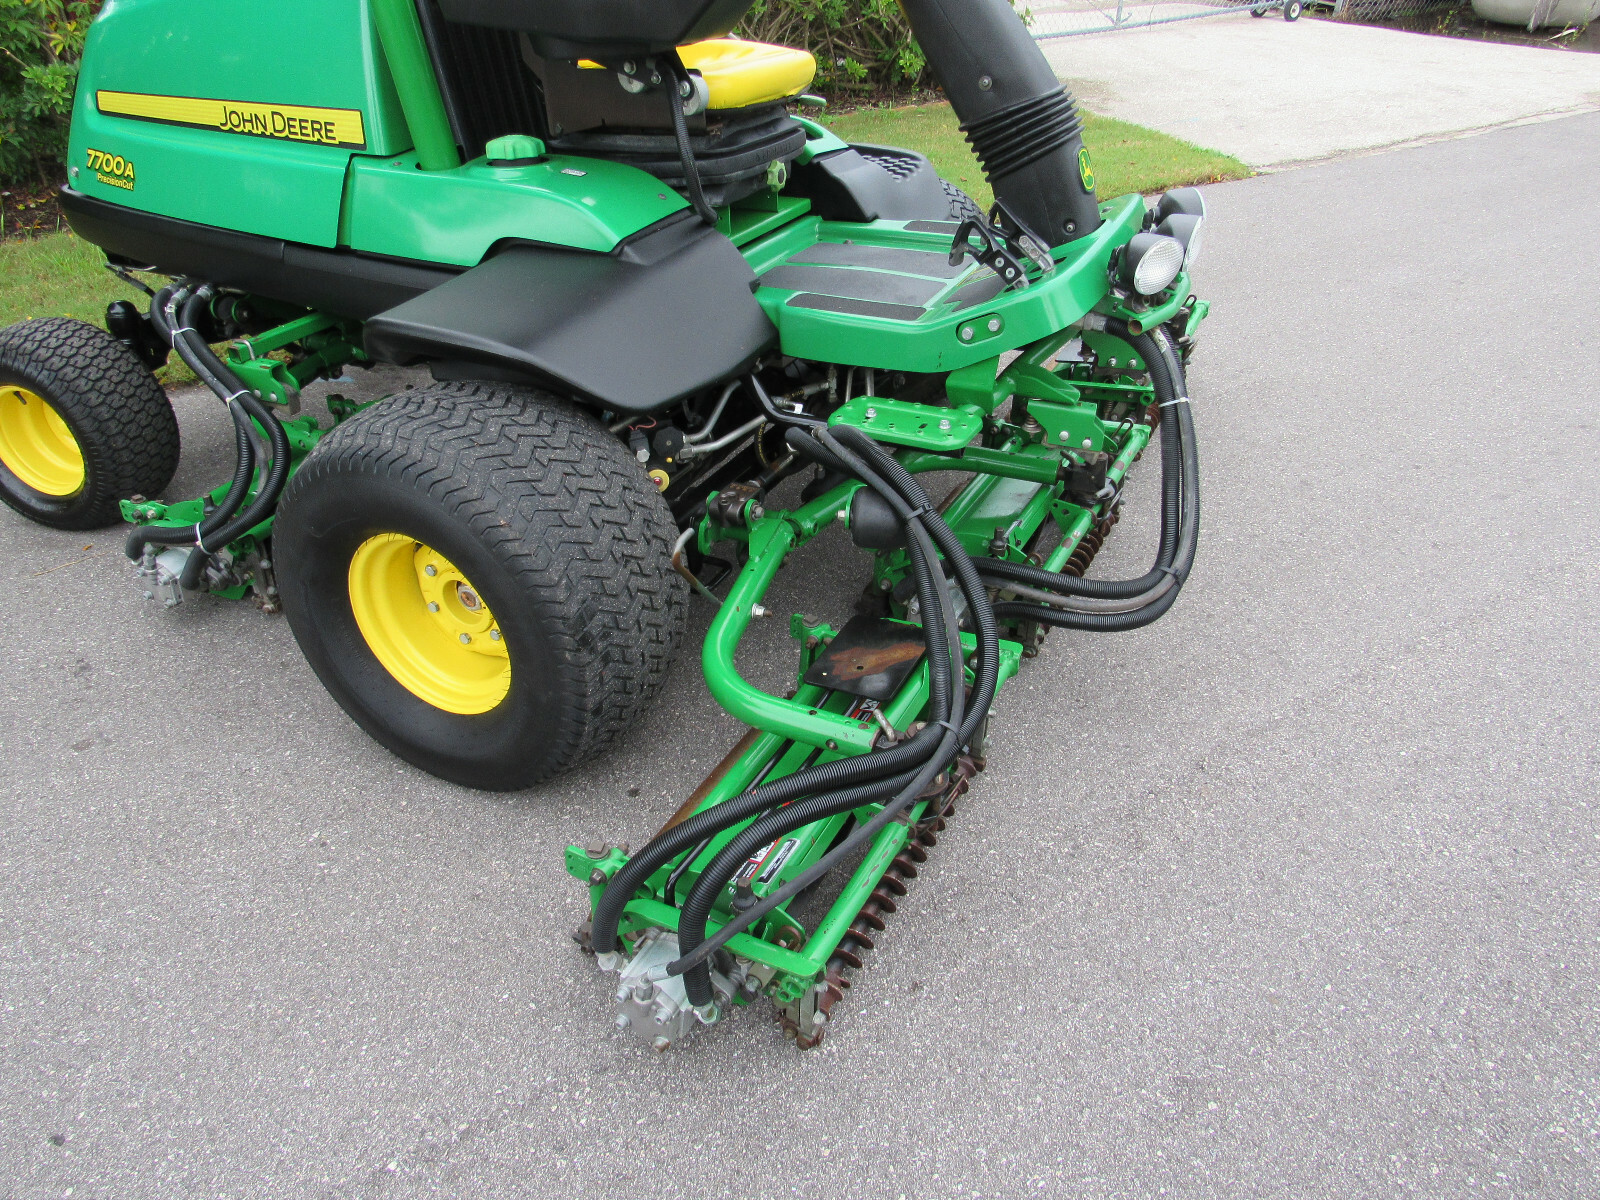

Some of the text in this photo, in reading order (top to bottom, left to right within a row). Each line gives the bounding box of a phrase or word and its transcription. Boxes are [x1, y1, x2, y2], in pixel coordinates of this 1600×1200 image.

[219, 105, 337, 141] JOHN DEERE
[87, 147, 135, 180] 7700A
[97, 171, 134, 191] PrecisionCut
